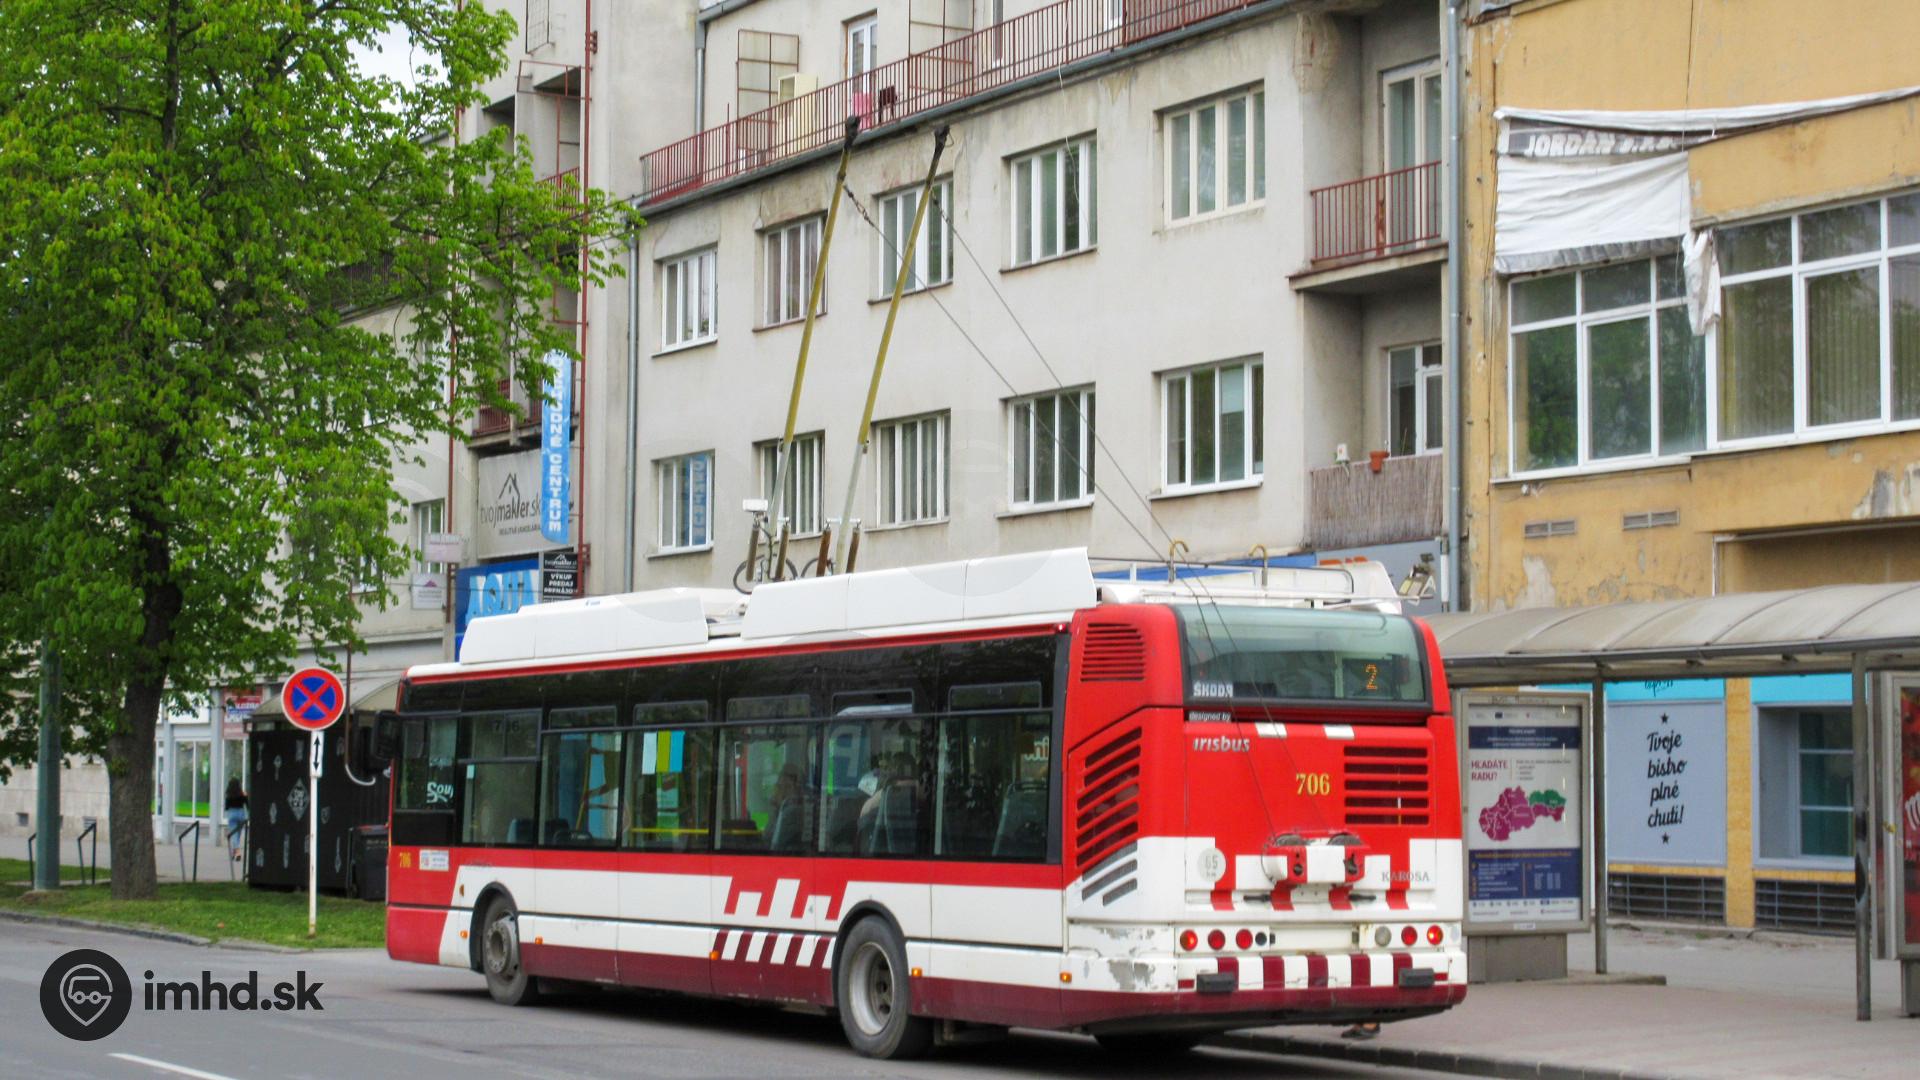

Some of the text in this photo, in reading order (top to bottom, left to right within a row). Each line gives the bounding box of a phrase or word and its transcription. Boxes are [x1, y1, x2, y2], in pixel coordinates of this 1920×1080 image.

[1524, 130, 1616, 157] JORDAN
[548, 453, 562, 532] CENTRUM
[1365, 663, 1378, 690] 2
[1188, 711, 1231, 722] designed by
[1193, 736, 1250, 752] irisbus
[1647, 730, 1683, 754] Tvoje
[1471, 771, 1498, 781] RADU?
[1647, 756, 1687, 779] bistro
[1296, 772, 1331, 795] 706
[1381, 871, 1430, 882] KAROSA
